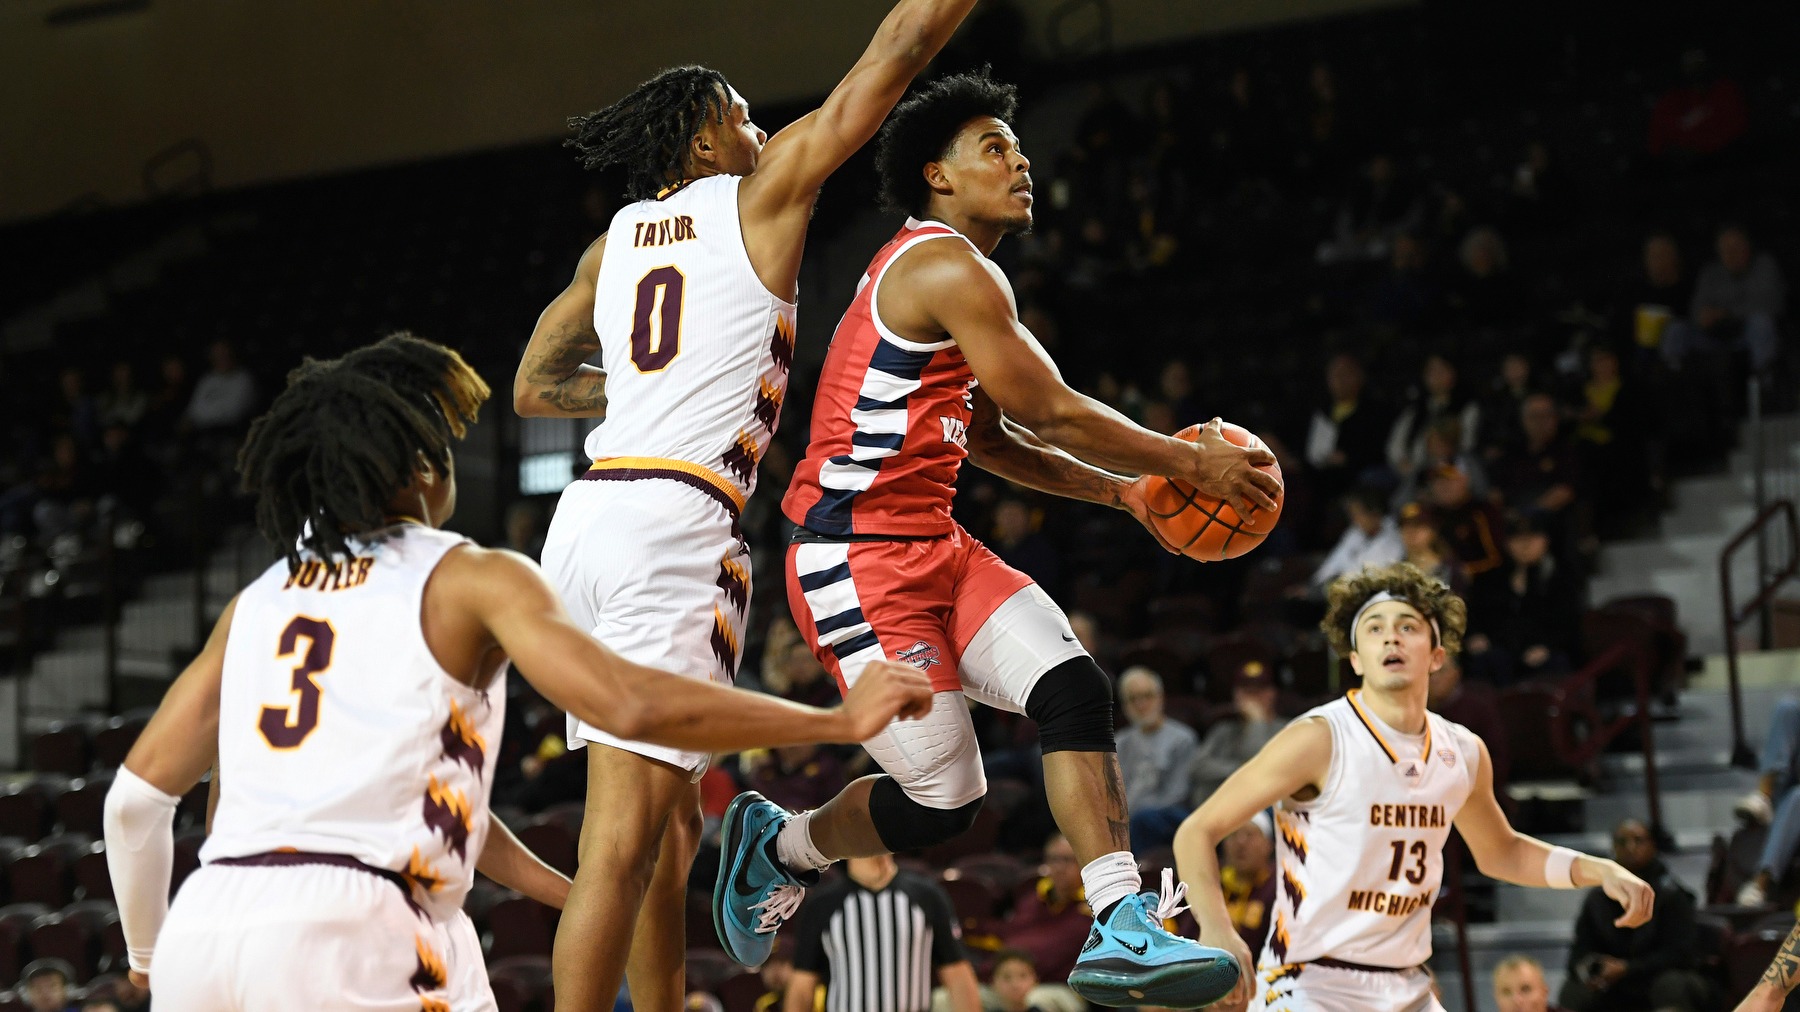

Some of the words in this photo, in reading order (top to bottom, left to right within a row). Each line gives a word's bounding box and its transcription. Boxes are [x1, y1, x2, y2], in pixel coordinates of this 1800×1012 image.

[634, 214, 698, 248] TAYLOR
[629, 263, 686, 374] 0
[281, 555, 376, 592] UTLER
[255, 612, 337, 752] 3
[1370, 804, 1446, 828] CENTRAL
[1387, 839, 1428, 886] 13
[1348, 890, 1432, 916] MICHIGN
